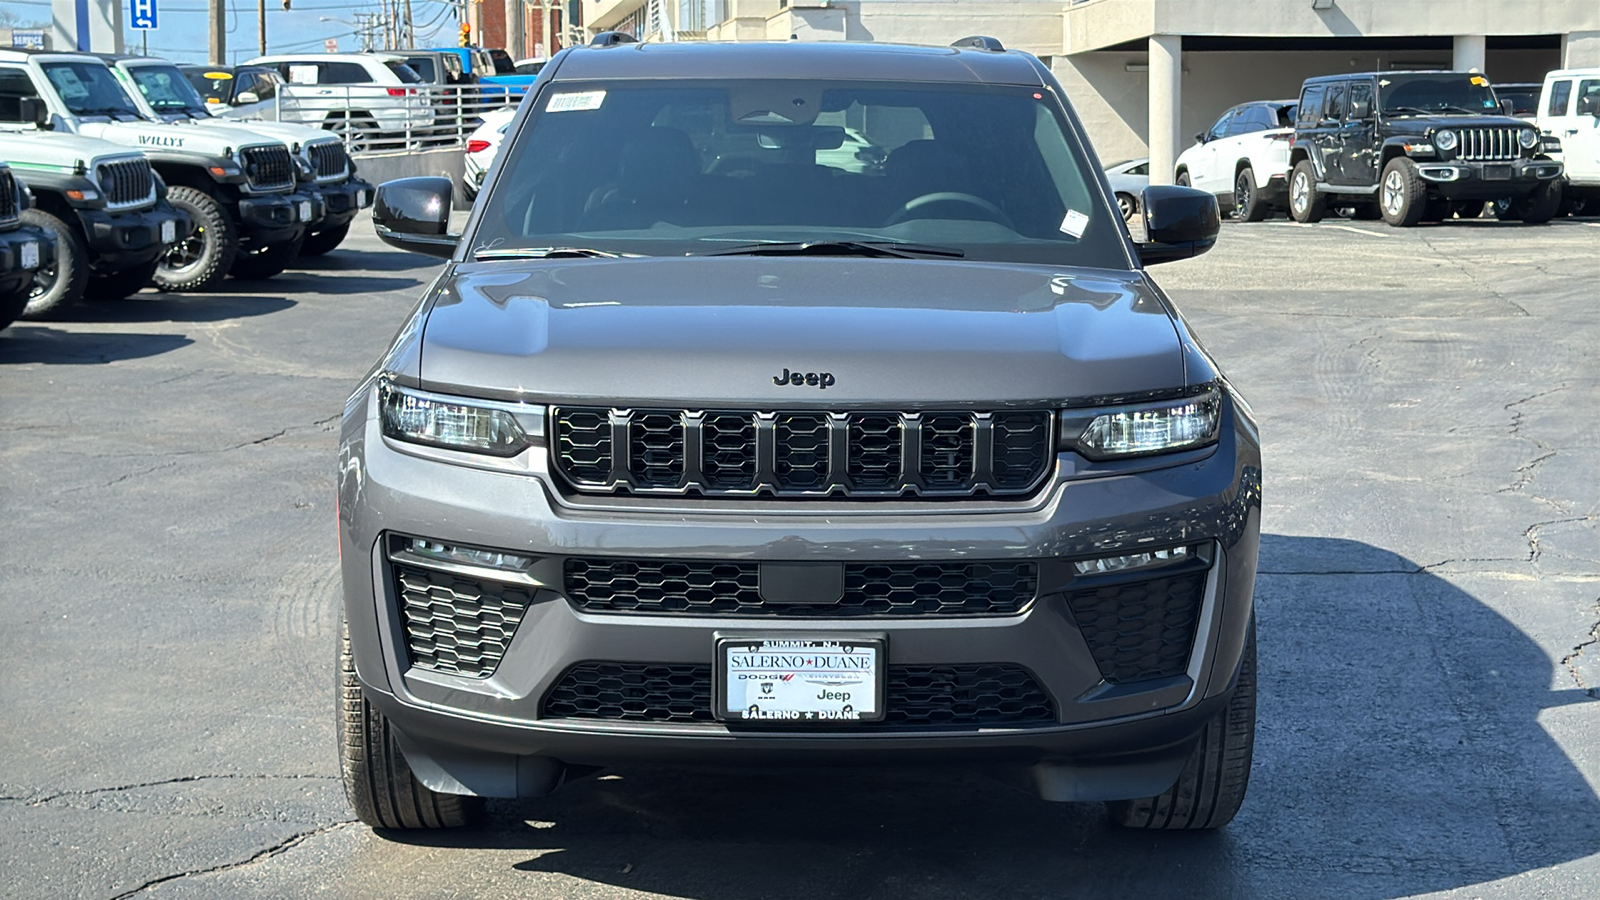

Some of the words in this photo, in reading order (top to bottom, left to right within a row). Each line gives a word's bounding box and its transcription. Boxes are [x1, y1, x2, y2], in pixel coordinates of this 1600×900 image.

[135, 0, 152, 18] H
[138, 135, 185, 147] WILLYS
[772, 368, 836, 390] Jeep
[731, 655, 805, 668] SALERNO
[814, 656, 871, 669] DUANE
[816, 689, 851, 702] Jeep
[741, 710, 800, 720] SALERNO
[818, 710, 861, 720] DUANE
